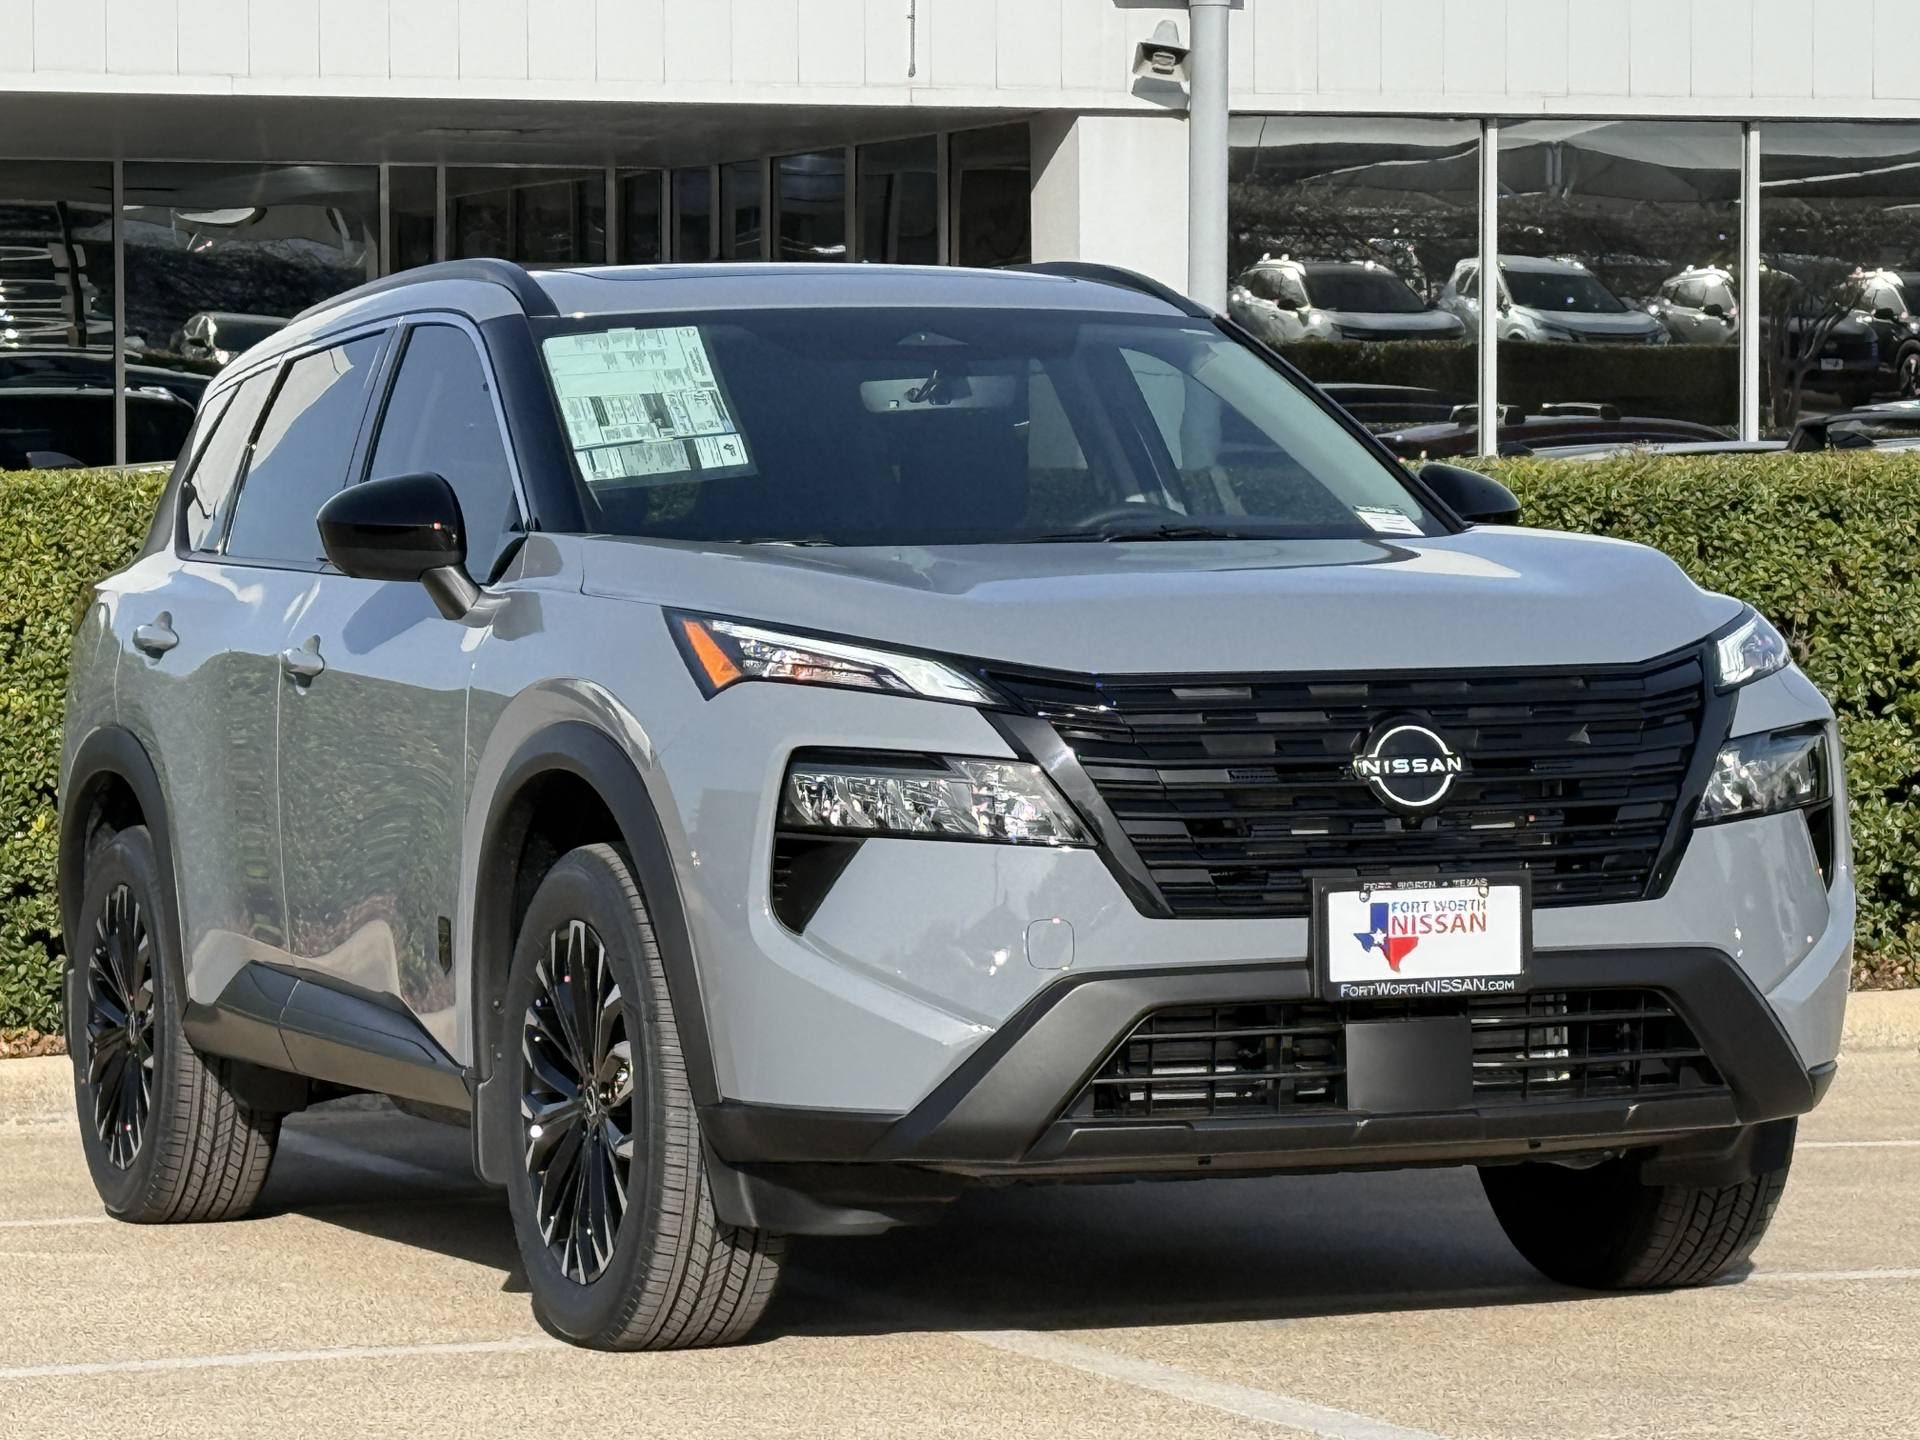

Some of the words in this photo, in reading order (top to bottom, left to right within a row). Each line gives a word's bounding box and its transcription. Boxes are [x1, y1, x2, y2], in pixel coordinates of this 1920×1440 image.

[1361, 757, 1463, 775] NISSAN
[1452, 878, 1488, 887] TEXAS
[1391, 902, 1429, 913] FORT
[1434, 900, 1487, 912] WORTH
[1391, 913, 1487, 935] NISSAN
